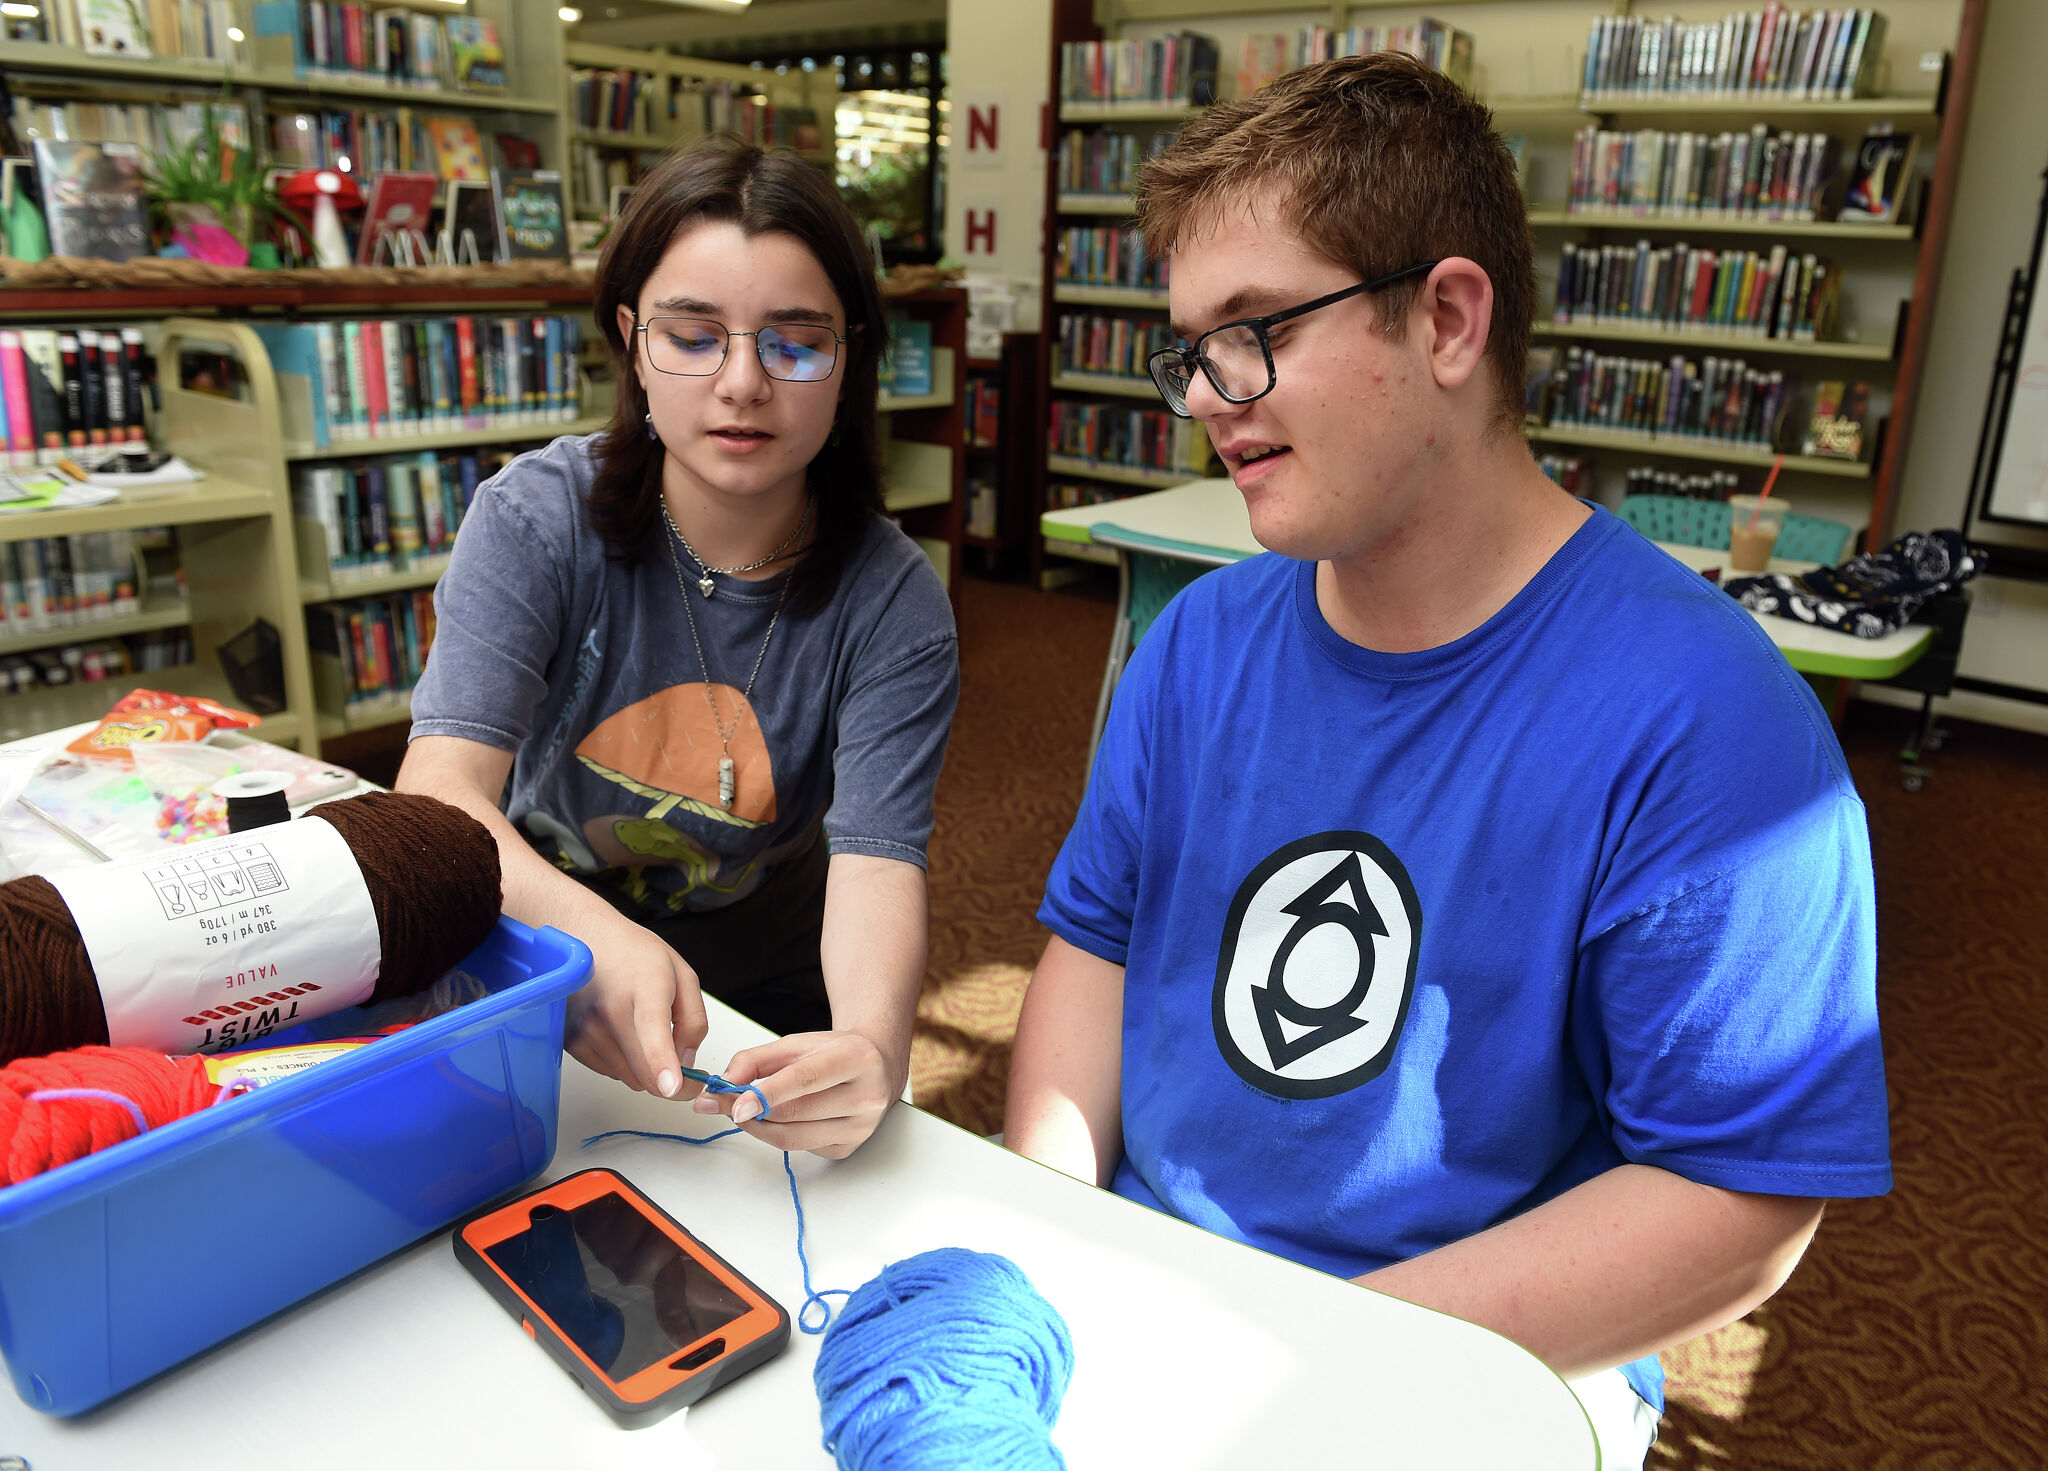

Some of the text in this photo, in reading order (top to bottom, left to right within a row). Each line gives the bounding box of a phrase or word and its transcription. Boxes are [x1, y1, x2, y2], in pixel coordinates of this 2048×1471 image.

[239, 910, 248, 919] m
[253, 904, 272, 918] 347
[200, 916, 227, 930] 170g
[257, 920, 277, 934] 380
[240, 923, 254, 939] yd
[205, 936, 218, 946] oz
[222, 933, 228, 944] 6
[225, 963, 278, 989] VALUE
[197, 1001, 299, 1049] TWIST
